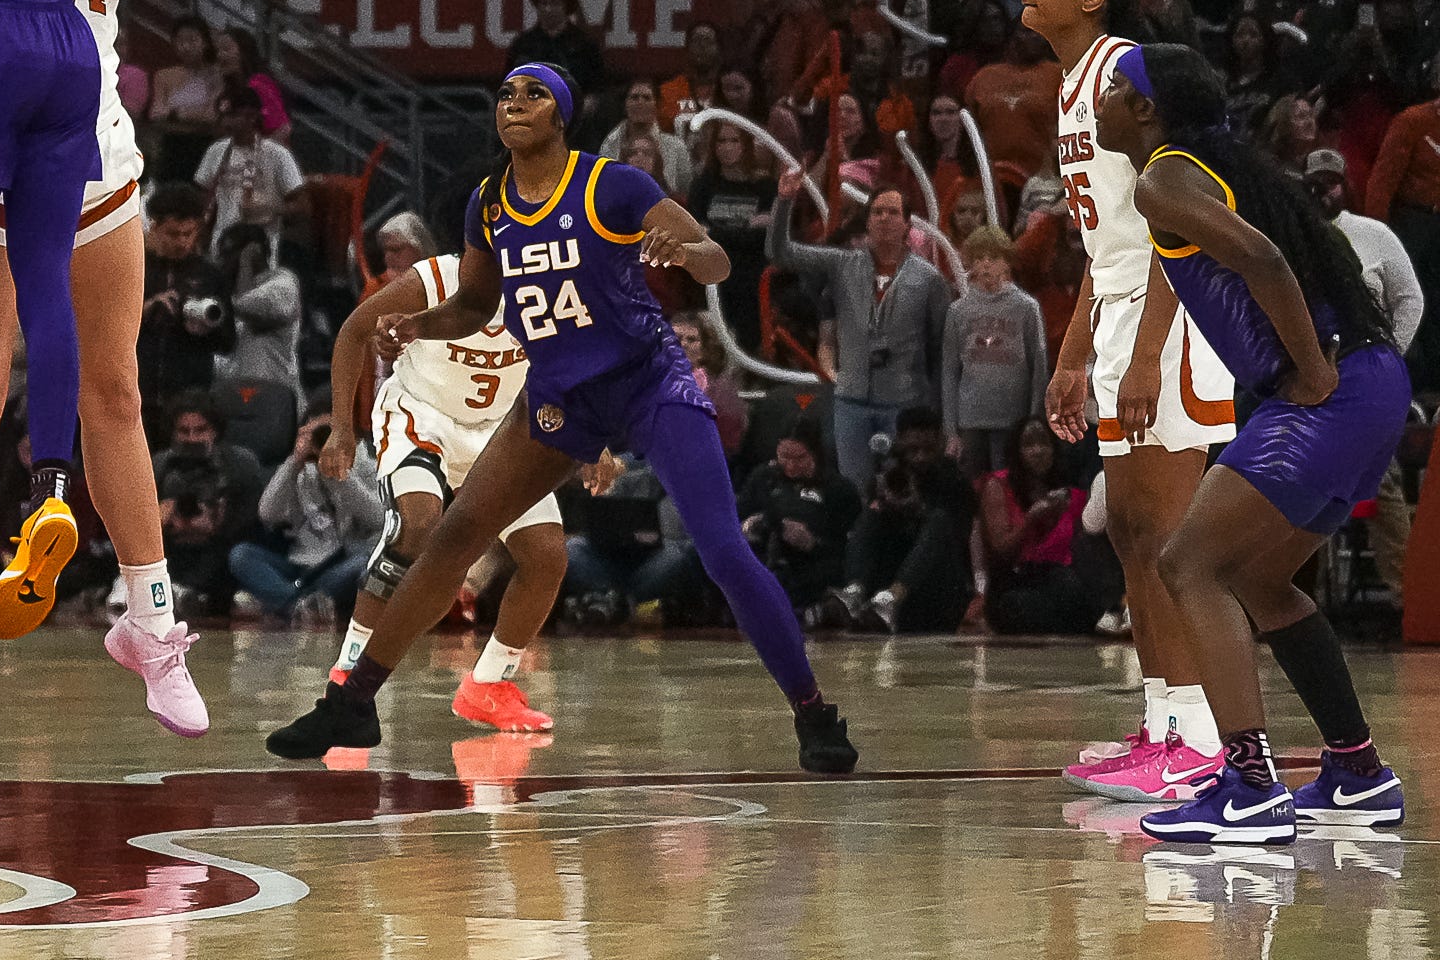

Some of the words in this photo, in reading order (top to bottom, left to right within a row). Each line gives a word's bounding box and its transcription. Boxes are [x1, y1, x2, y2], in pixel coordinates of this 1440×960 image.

[1058, 131, 1094, 165] XAS
[500, 239, 581, 277] LSU
[515, 280, 593, 341] 24
[446, 342, 528, 370] TEXAS
[465, 374, 500, 409] 3
